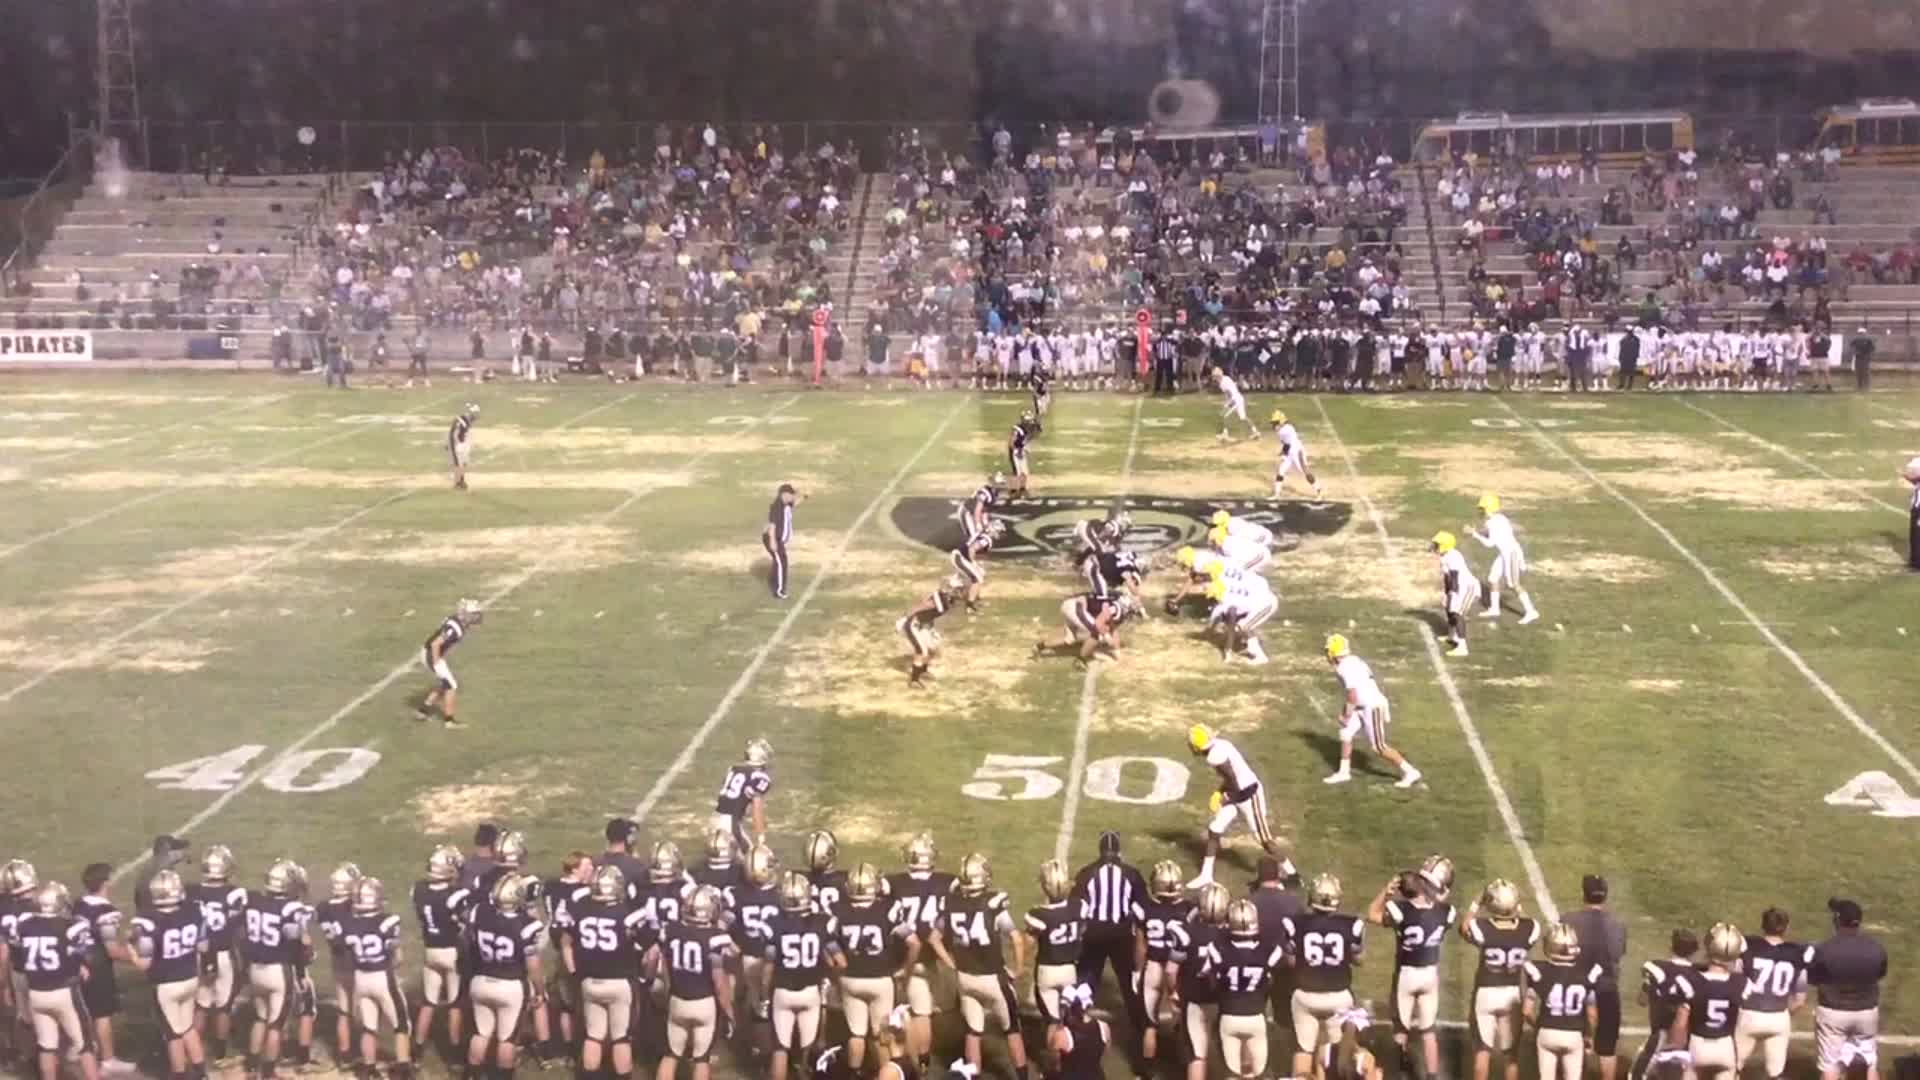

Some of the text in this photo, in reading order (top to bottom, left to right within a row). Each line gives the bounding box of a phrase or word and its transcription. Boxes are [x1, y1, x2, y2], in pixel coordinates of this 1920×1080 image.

[1, 335, 85, 355] PIRATES
[143, 744, 382, 792] 40
[961, 753, 1191, 804] 50
[478, 929, 515, 961] 52
[579, 916, 619, 951] 55
[841, 924, 884, 955] 73
[950, 911, 991, 947] 54
[22, 935, 61, 971] 75
[669, 938, 703, 973] 10
[781, 932, 820, 969] 50
[1303, 931, 1345, 967] 63
[1226, 965, 1265, 992] 17
[1752, 957, 1794, 997] 70
[1546, 983, 1587, 1016] 40
[1705, 999, 1730, 1028] 5
